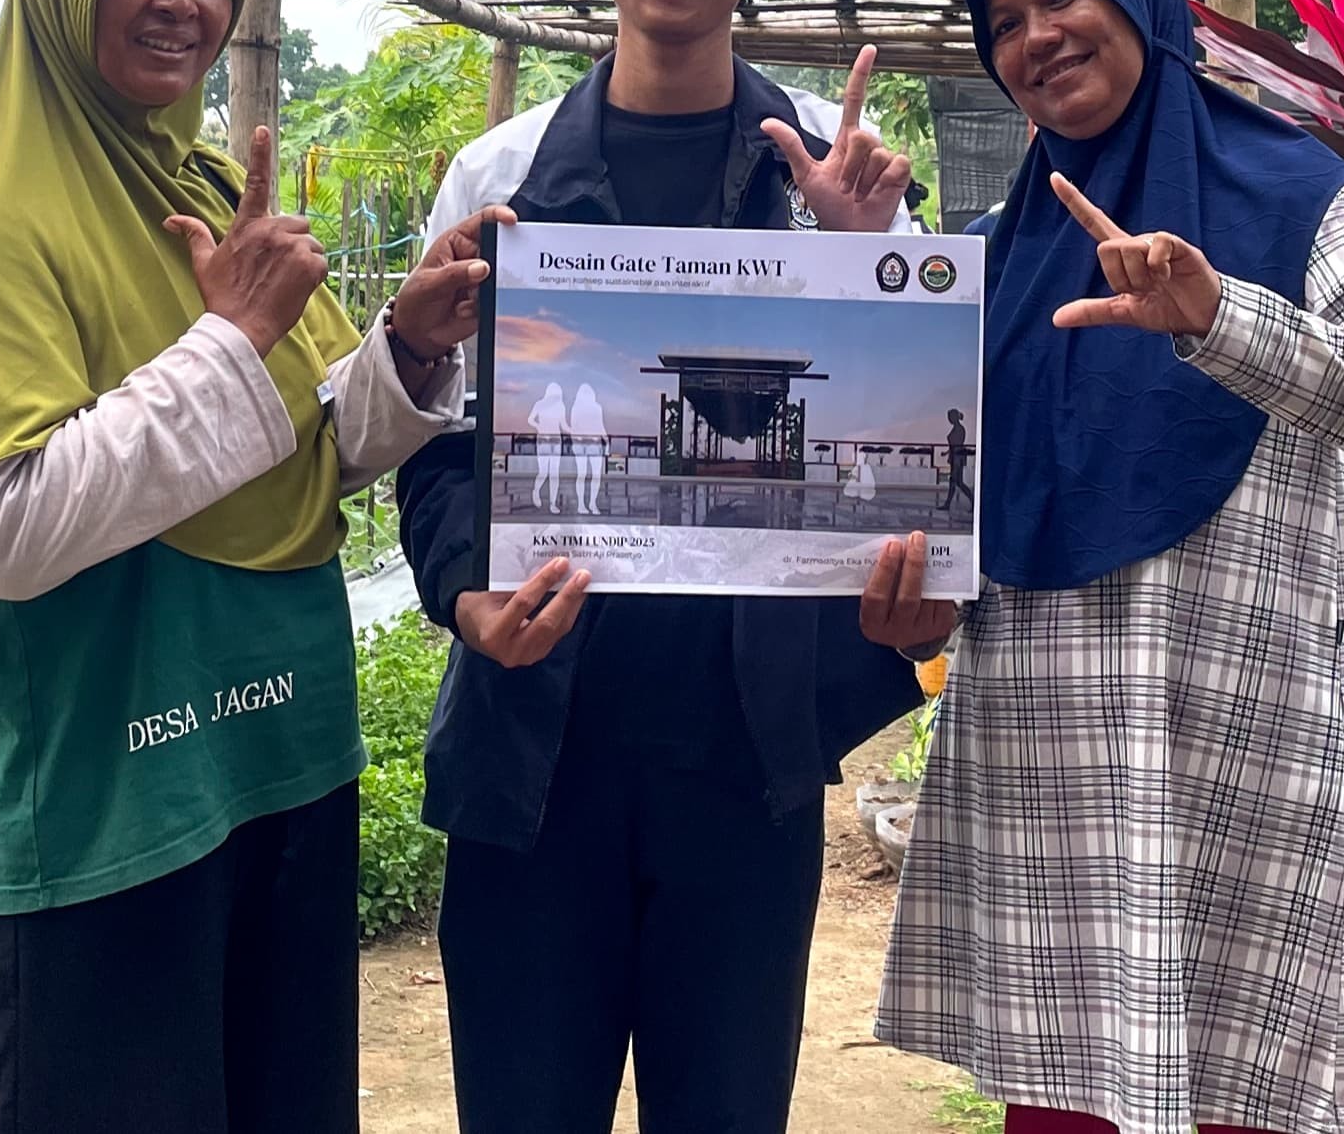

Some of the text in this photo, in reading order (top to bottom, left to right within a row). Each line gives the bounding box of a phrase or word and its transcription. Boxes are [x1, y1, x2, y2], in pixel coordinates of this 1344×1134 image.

[538, 251, 787, 276] Desain Gate Taman KWT
[533, 535, 558, 547] KKN
[560, 535, 583, 547] TIM
[629, 536, 655, 547] 2025
[127, 672, 294, 753] DESA JAGAN
